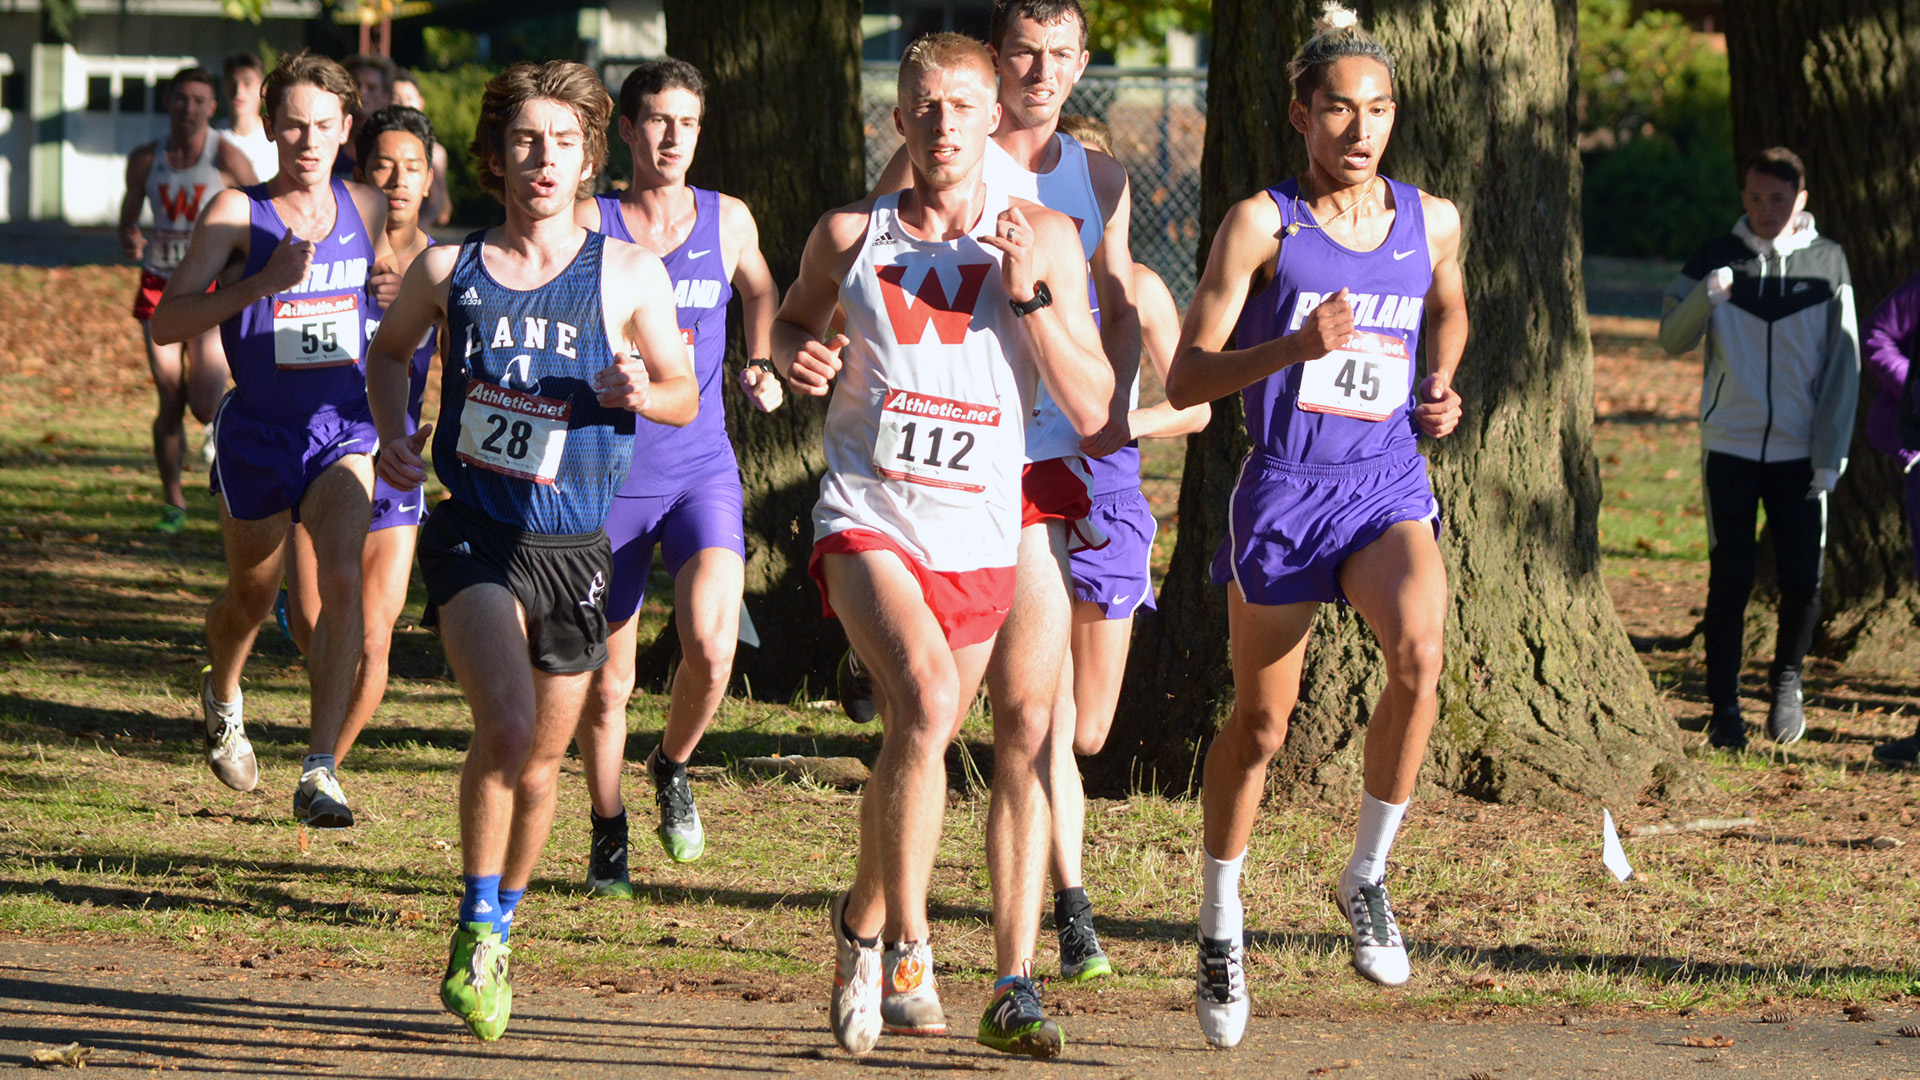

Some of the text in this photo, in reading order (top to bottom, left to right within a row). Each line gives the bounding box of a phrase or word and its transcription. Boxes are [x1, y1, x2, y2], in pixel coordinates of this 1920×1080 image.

[157, 183, 208, 222] W
[277, 298, 354, 317] Athletic.net
[873, 263, 992, 345] W
[302, 321, 338, 354] 55
[465, 316, 577, 360] LANE
[468, 383, 566, 417] Athletic.net
[1334, 358, 1381, 401] 45
[886, 391, 998, 423] Athletic.net
[481, 413, 533, 460] 28
[896, 421, 976, 472] 112
